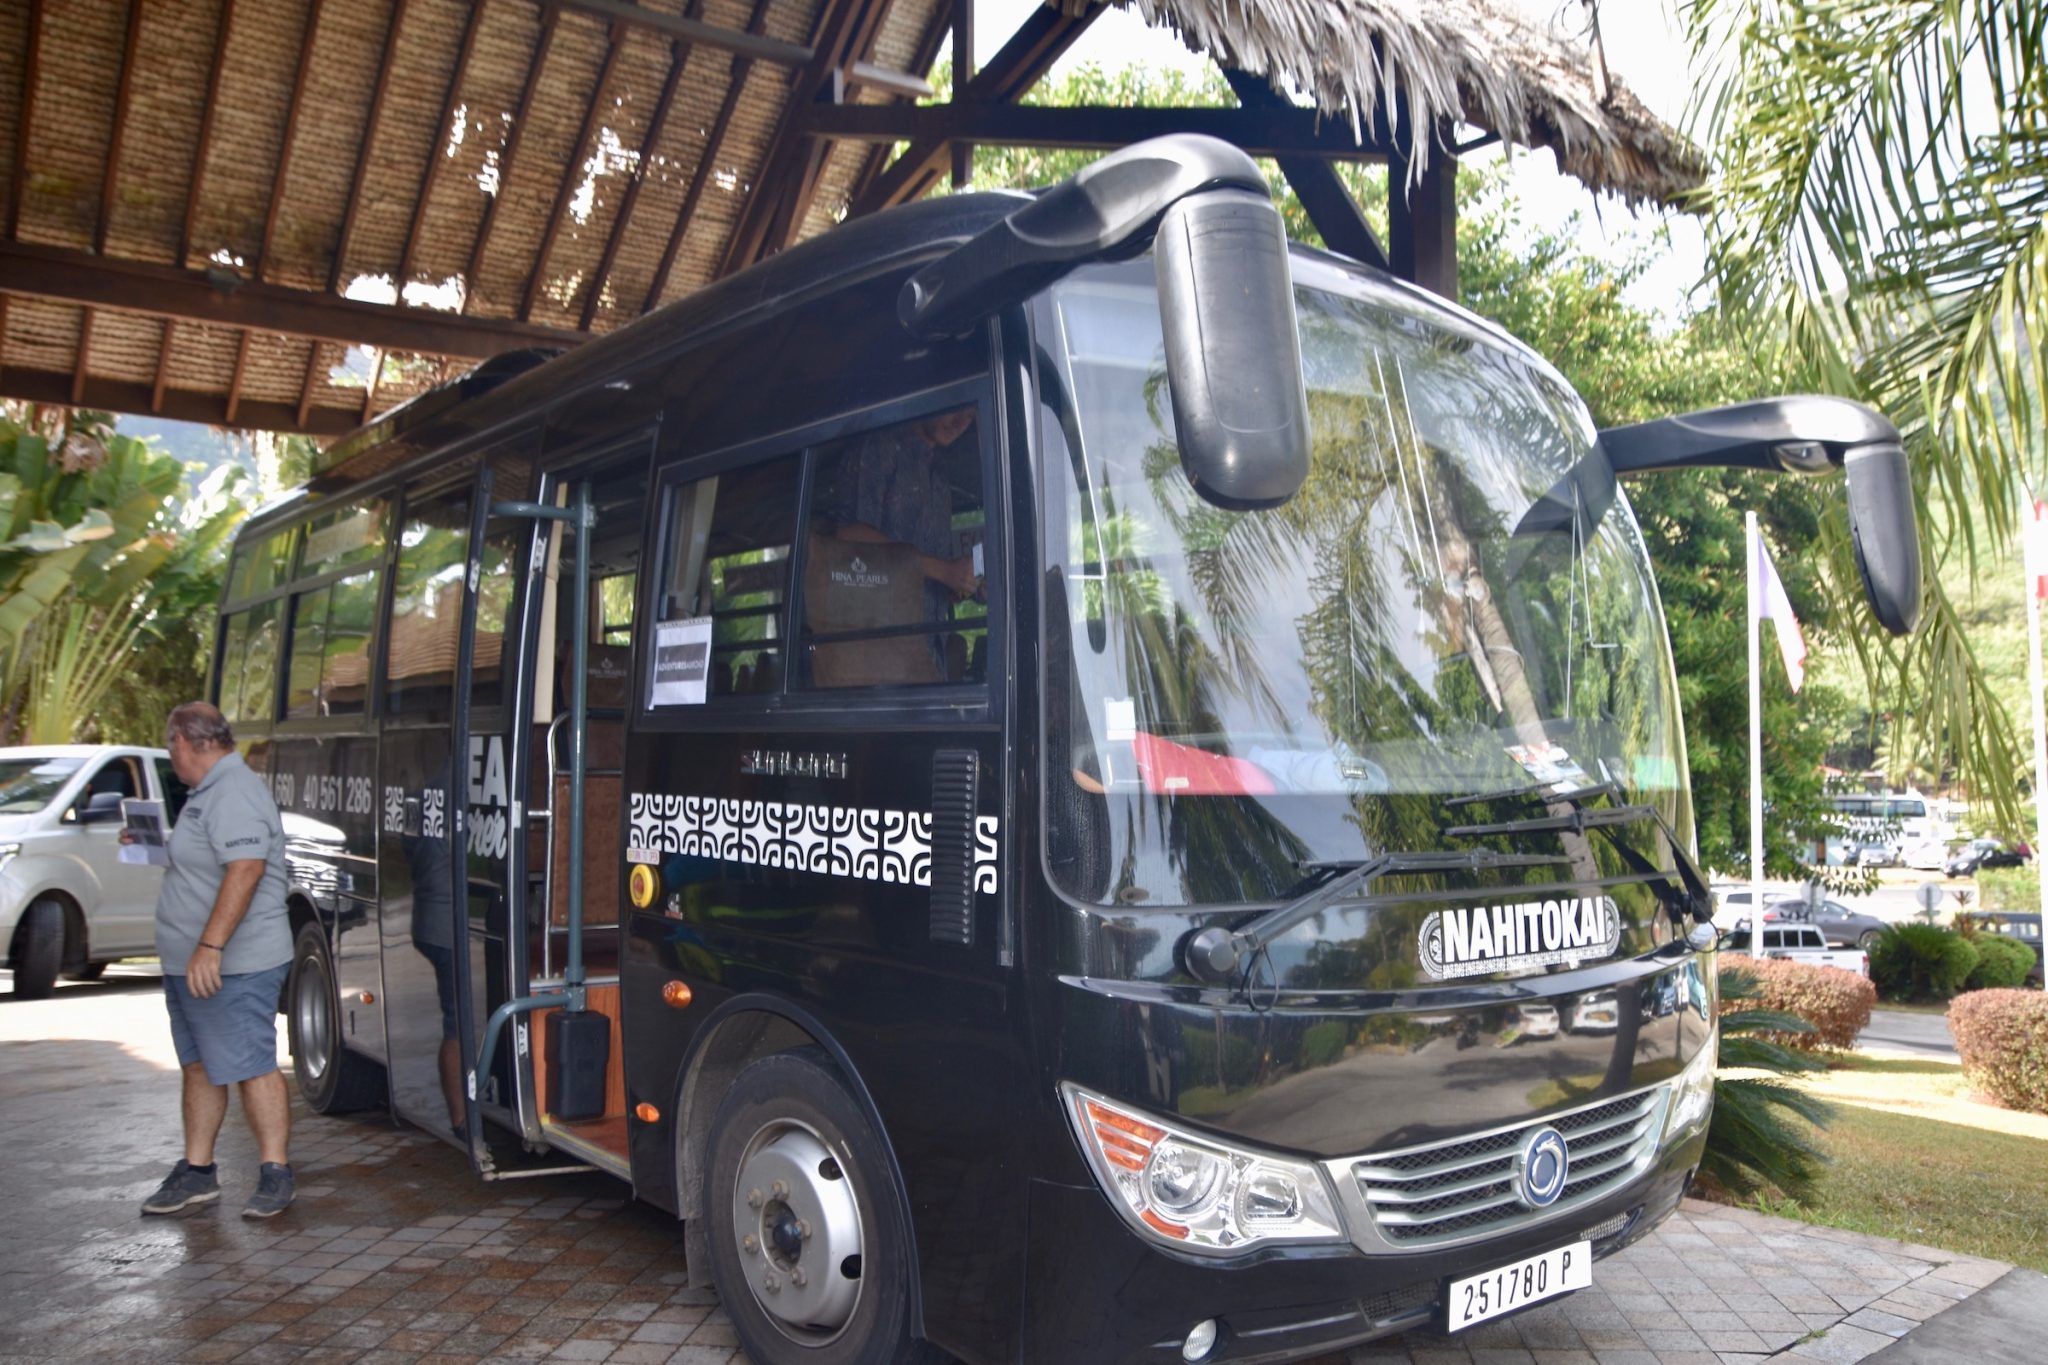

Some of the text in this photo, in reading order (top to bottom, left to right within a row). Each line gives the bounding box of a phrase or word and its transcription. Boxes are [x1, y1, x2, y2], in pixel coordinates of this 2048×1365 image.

[303, 774, 319, 810] 40
[321, 775, 343, 812] 561
[345, 776, 372, 815] 286
[1442, 895, 1606, 963] NAHITOKAI
[1463, 1250, 1571, 1322] 251780 P
